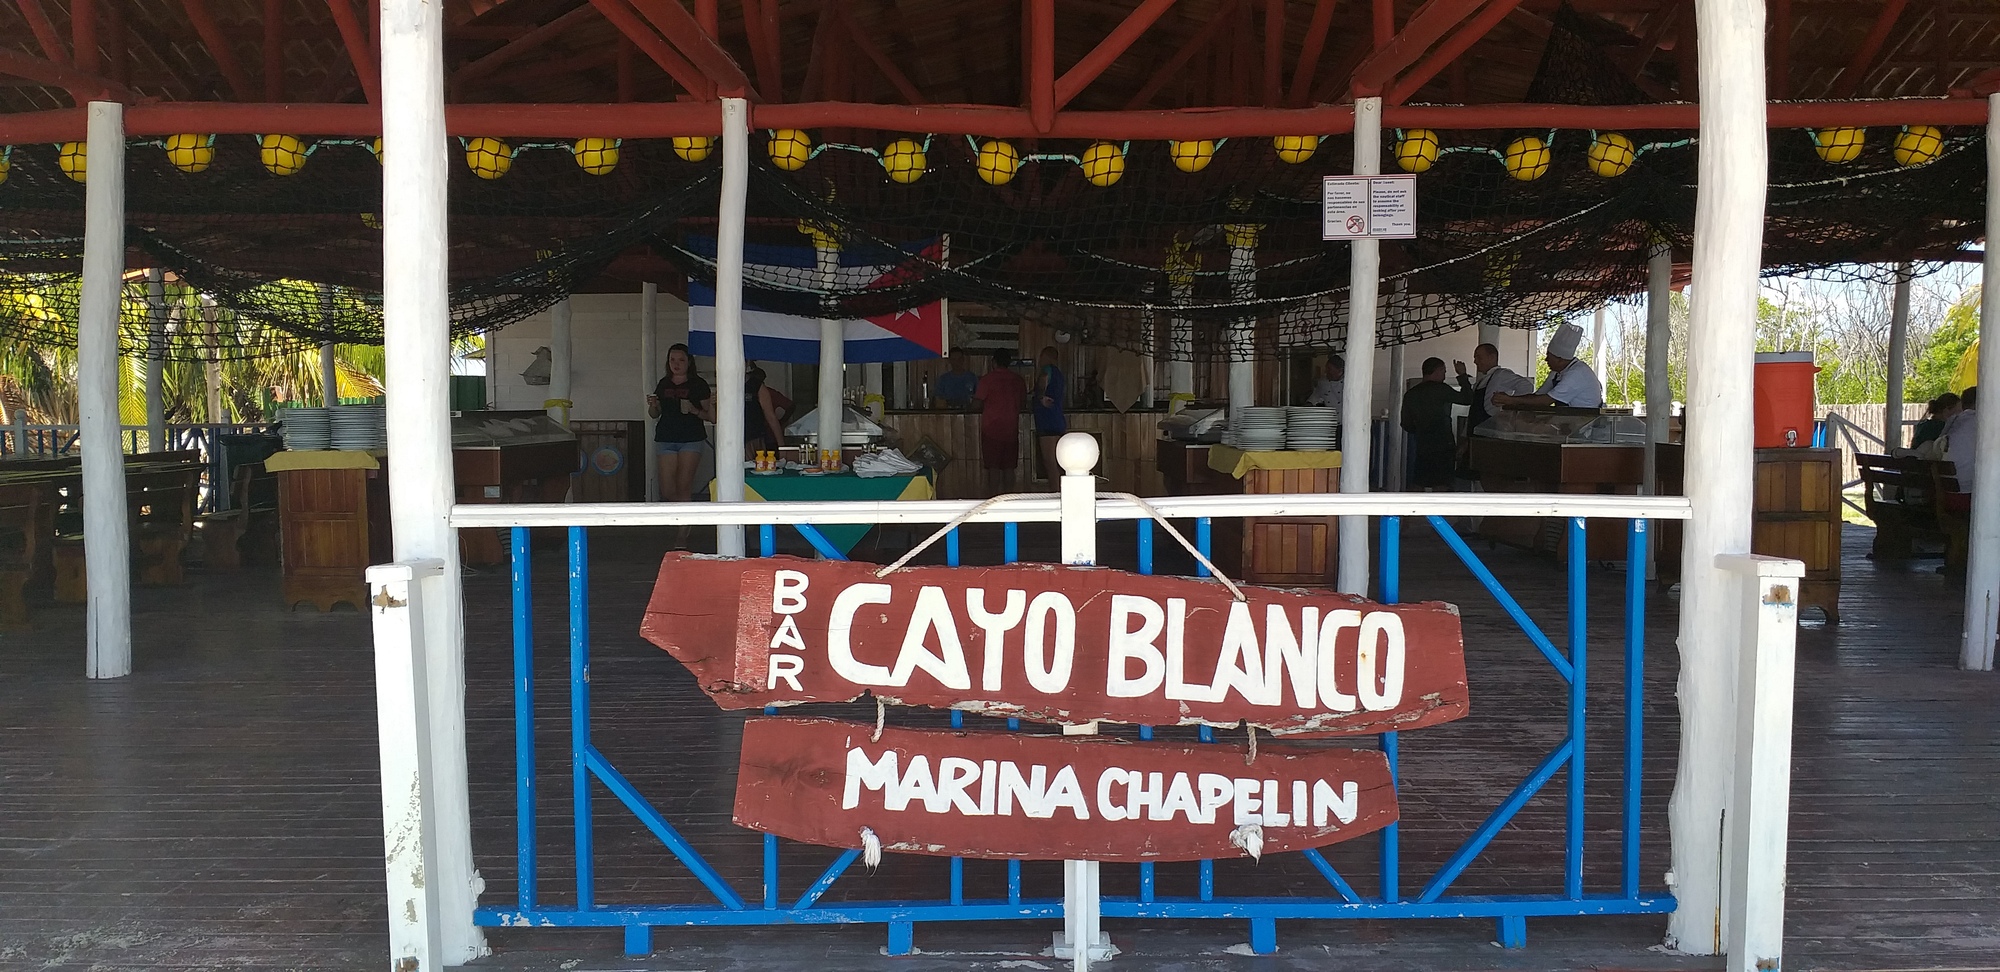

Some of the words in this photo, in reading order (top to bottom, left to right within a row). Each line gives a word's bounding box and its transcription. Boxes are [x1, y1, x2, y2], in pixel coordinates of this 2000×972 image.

[767, 569, 809, 692] BAR
[828, 582, 1076, 694] CAYO
[1106, 594, 1406, 712] BLANCO
[842, 746, 1090, 820] MARINA
[1096, 767, 1359, 828] CHAPELIN
